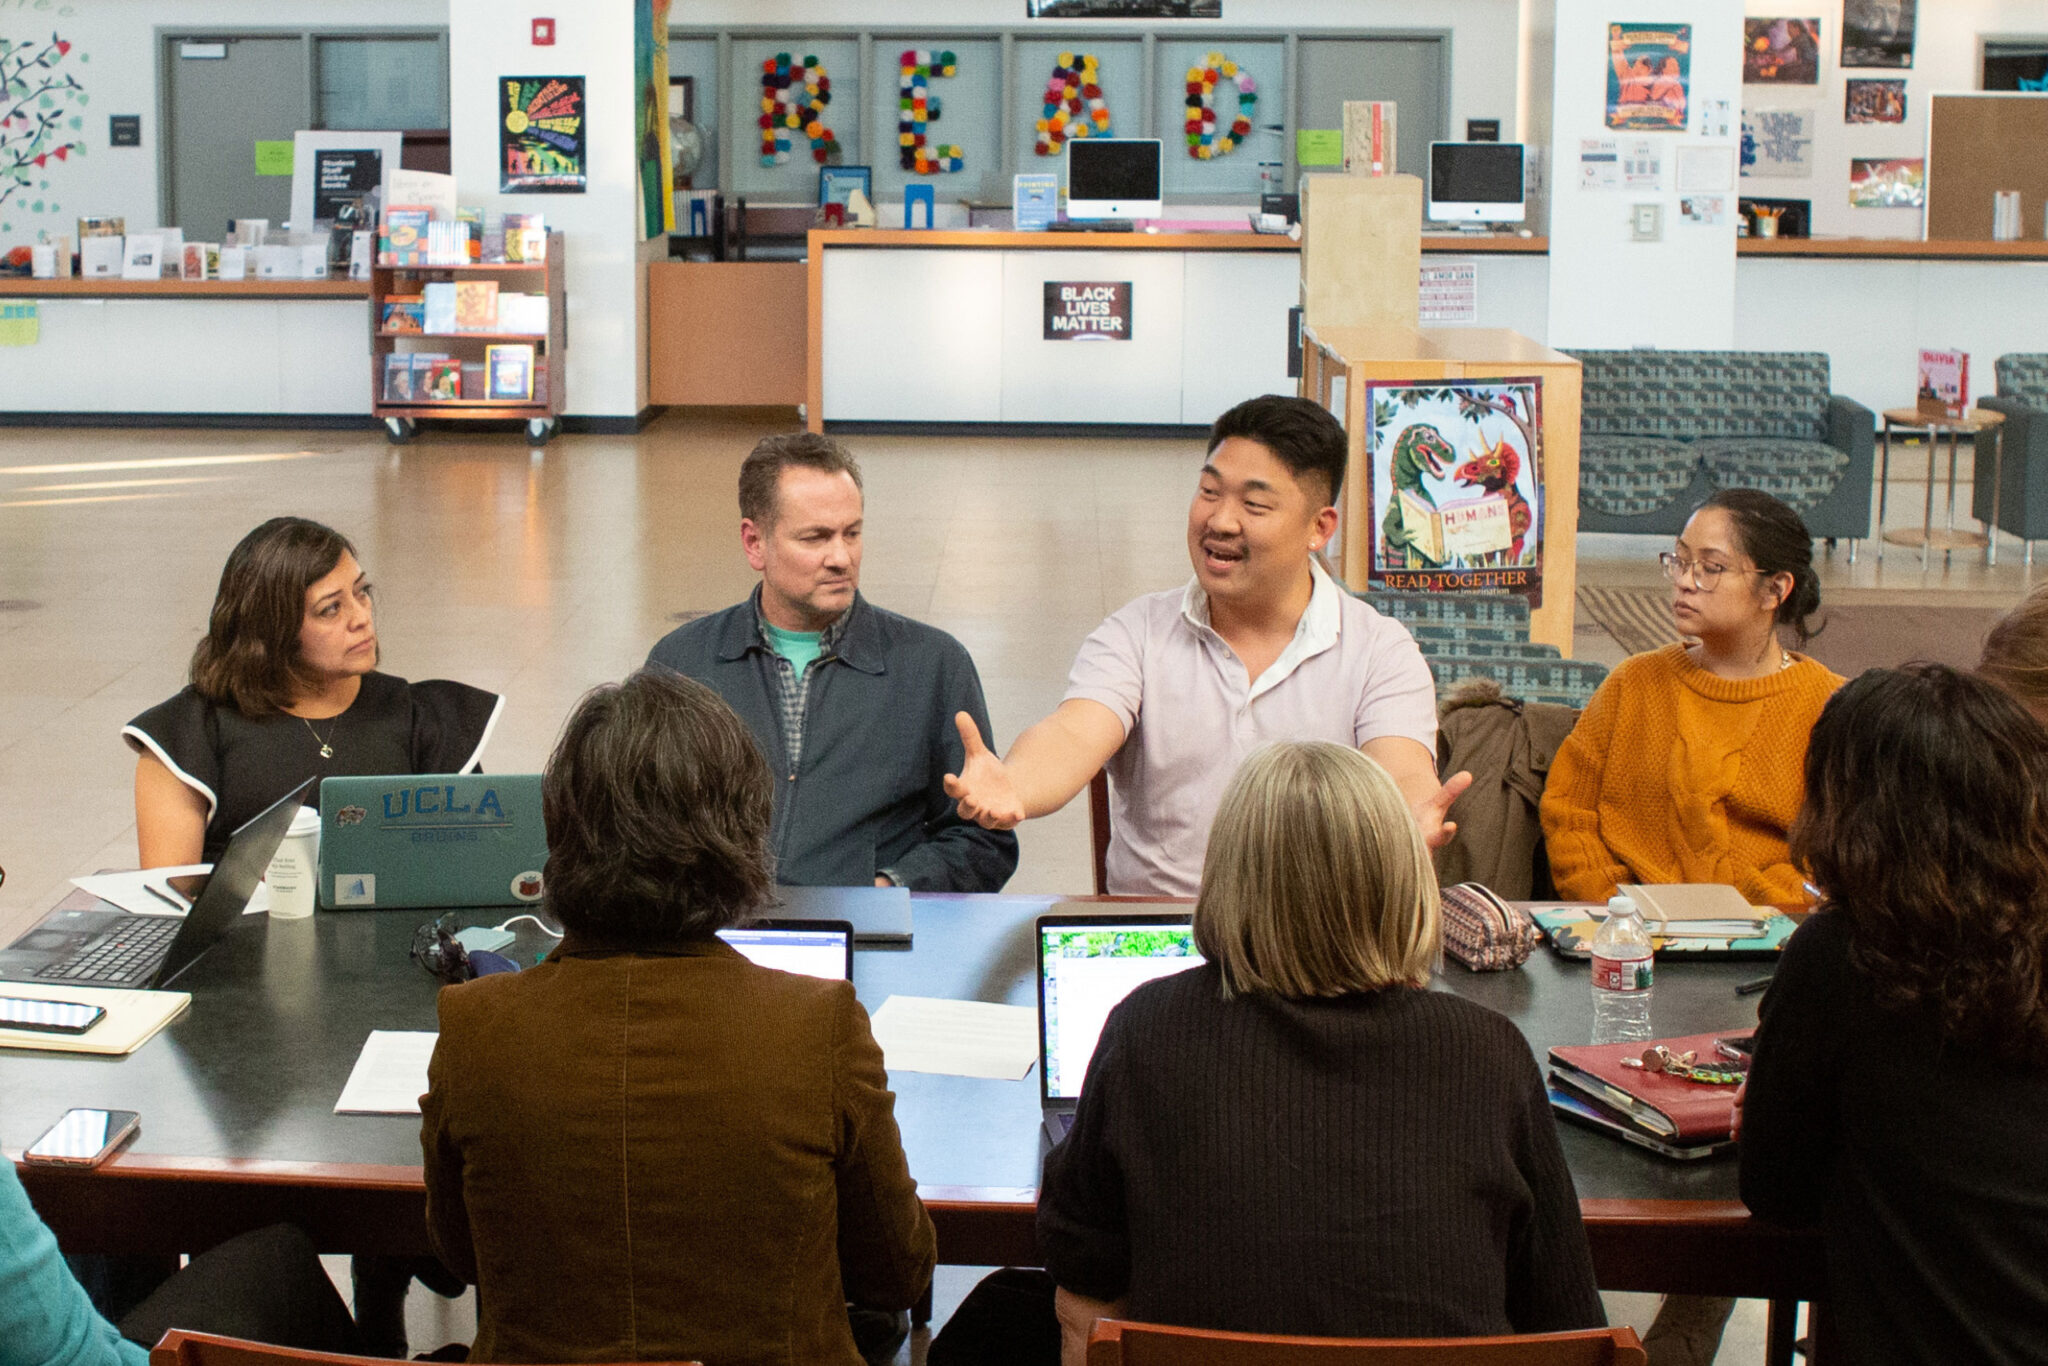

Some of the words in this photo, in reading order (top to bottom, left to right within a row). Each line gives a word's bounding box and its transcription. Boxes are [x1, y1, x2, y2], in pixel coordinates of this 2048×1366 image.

[758, 50, 1259, 174] READ
[322, 160, 356, 168] Student
[1061, 287, 1116, 301] BLACK
[1066, 301, 1111, 315] LIVES
[1052, 315, 1123, 331] MATTER
[1922, 352, 1955, 365] OLIVIA
[1444, 502, 1505, 526] HUMANS
[1385, 574, 1431, 588] READ
[1434, 570, 1527, 587] TOGETHER
[382, 785, 506, 819] UCLA
